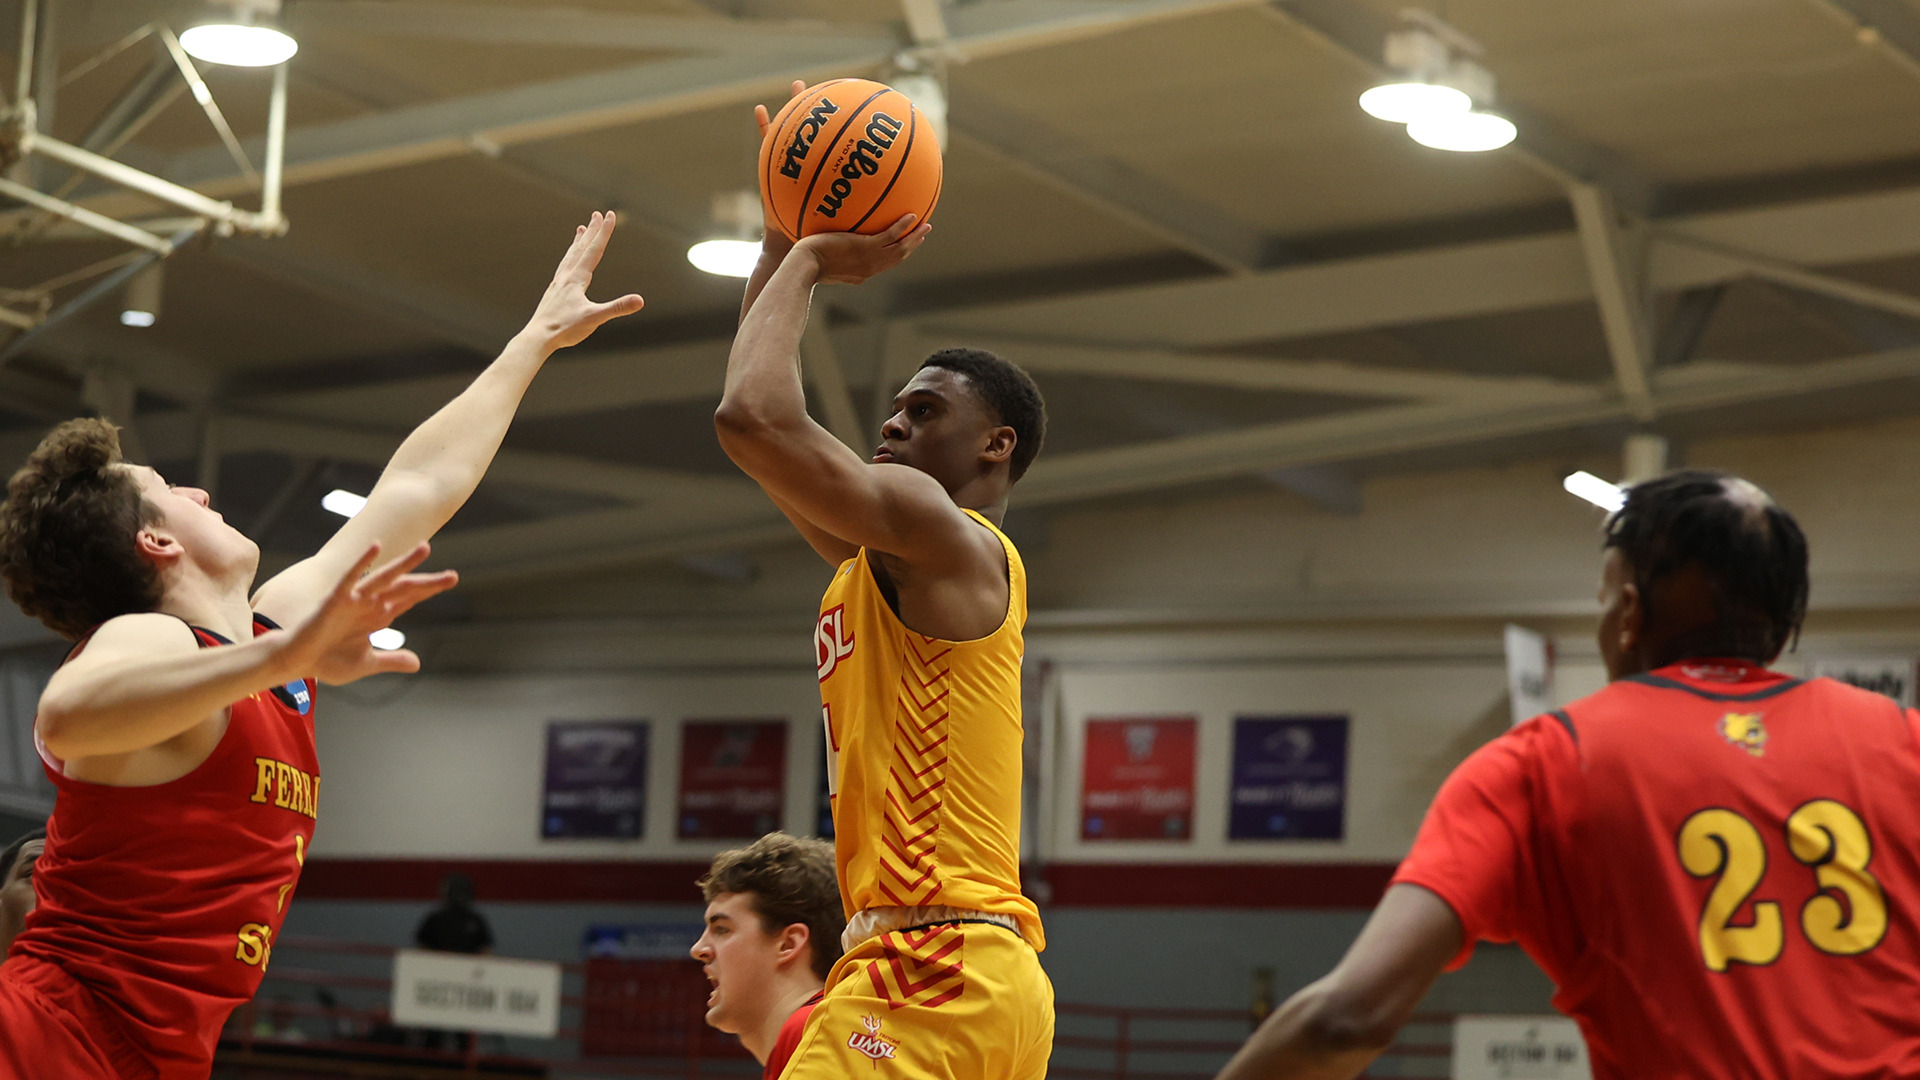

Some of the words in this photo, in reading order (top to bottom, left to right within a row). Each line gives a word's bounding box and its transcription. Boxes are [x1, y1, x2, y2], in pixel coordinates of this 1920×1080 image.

[779, 97, 841, 180] NCAA
[815, 111, 905, 219] Wilson
[831, 155, 845, 174] NXT
[840, 138, 855, 156] EVO
[1676, 797, 1889, 974] 23
[846, 1030, 898, 1060] UMSL
